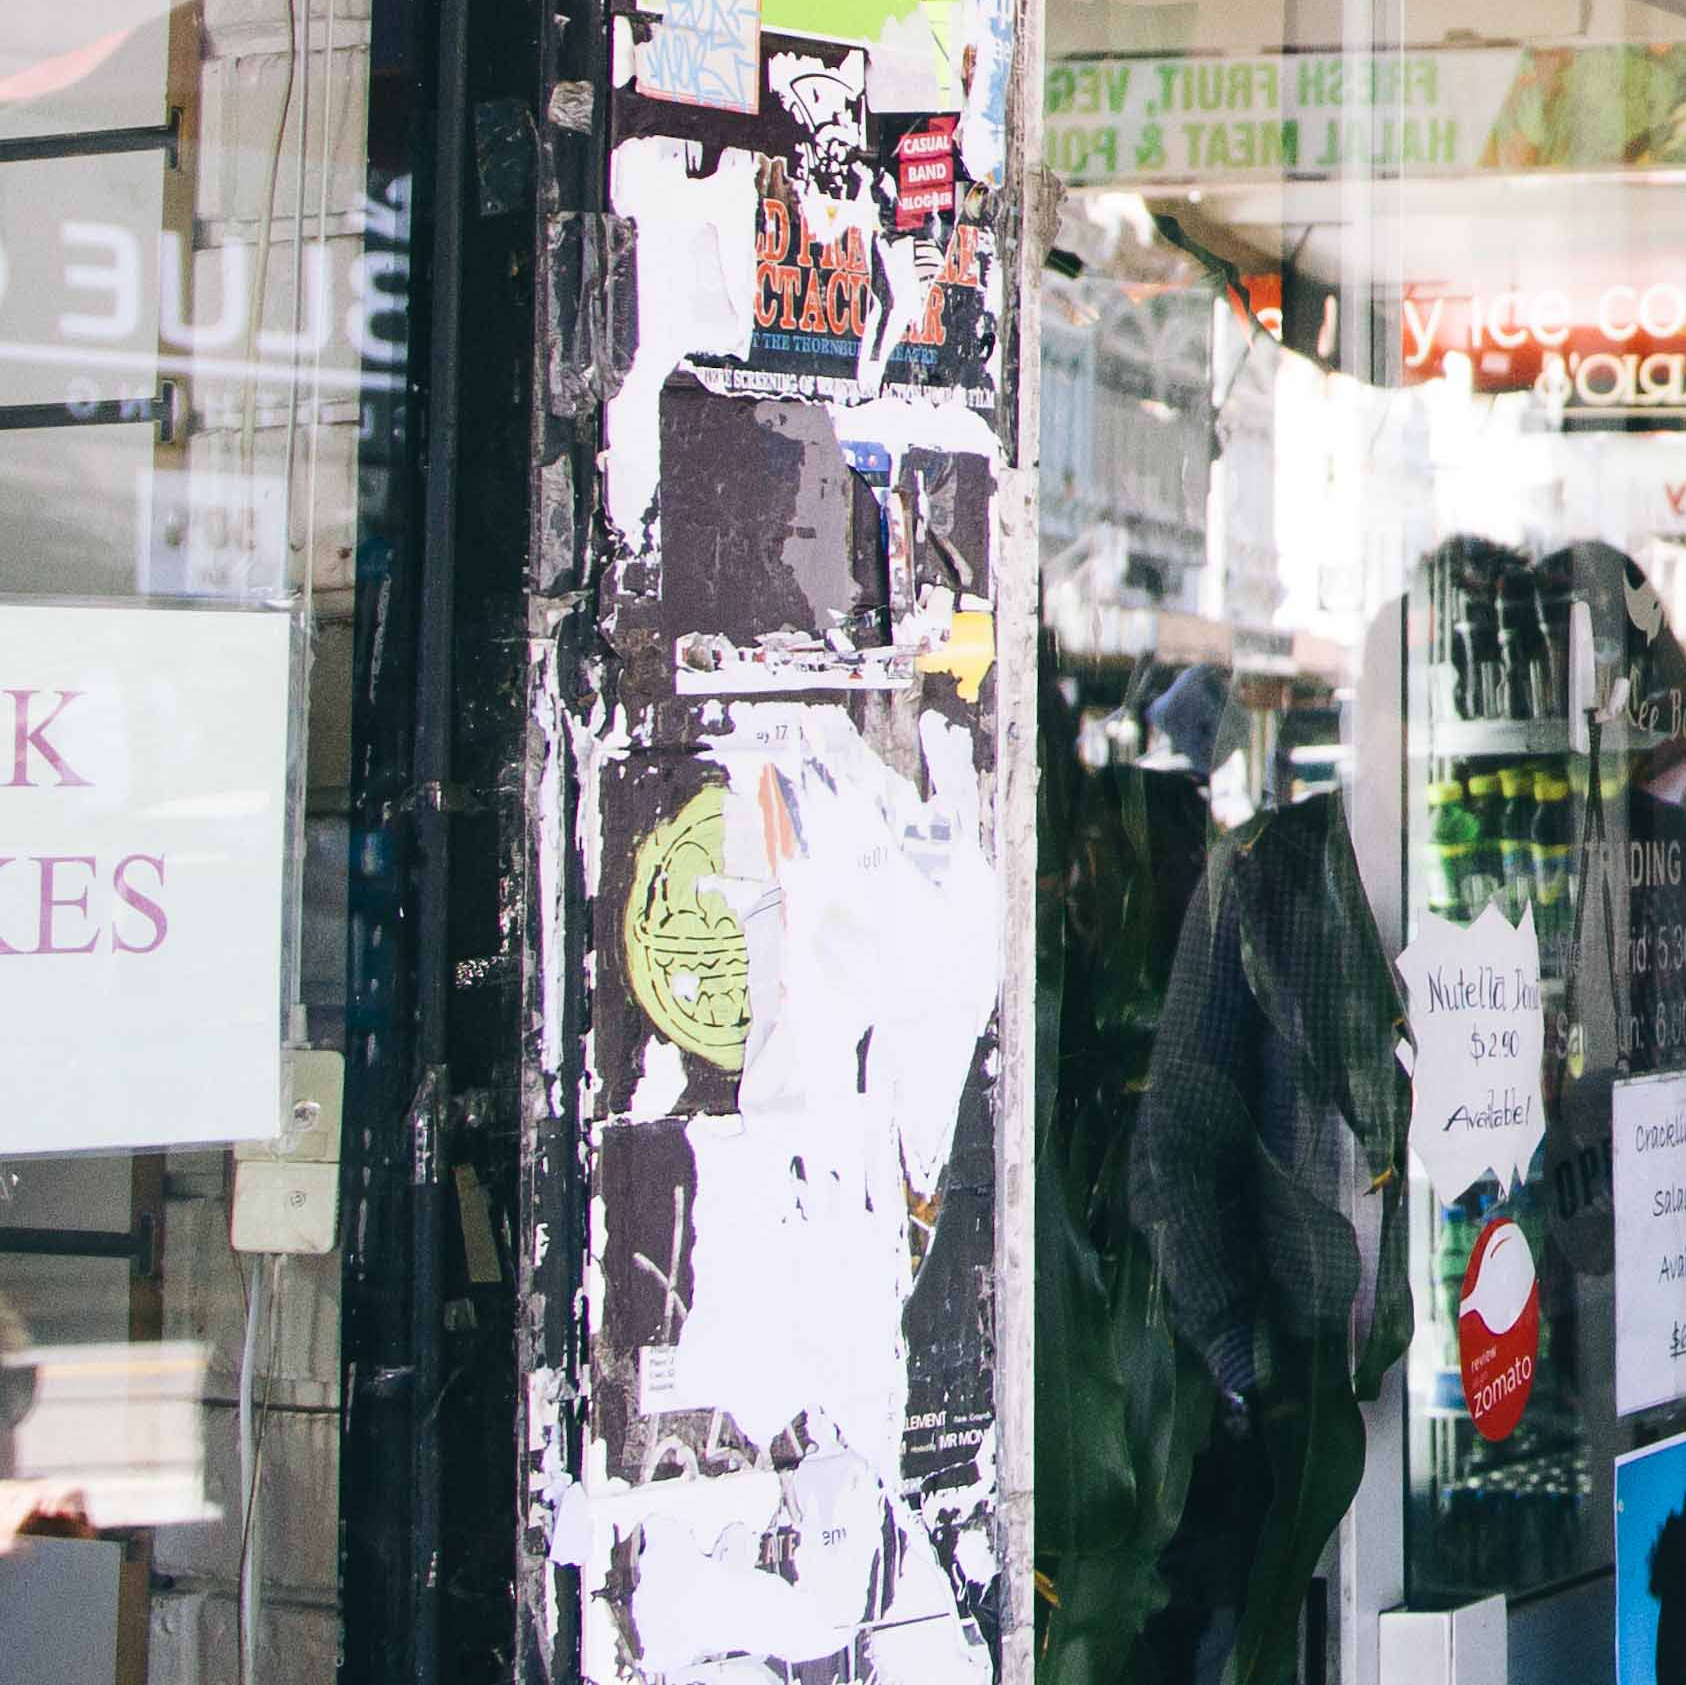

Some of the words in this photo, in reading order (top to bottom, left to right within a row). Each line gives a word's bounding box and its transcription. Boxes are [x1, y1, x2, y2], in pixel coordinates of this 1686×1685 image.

[903, 134, 951, 155] CASUAL
[907, 163, 947, 182] BAND
[764, 333, 790, 350] THE
[1585, 840, 1680, 887] TRDING
[1473, 1355, 1532, 1420] zomato
